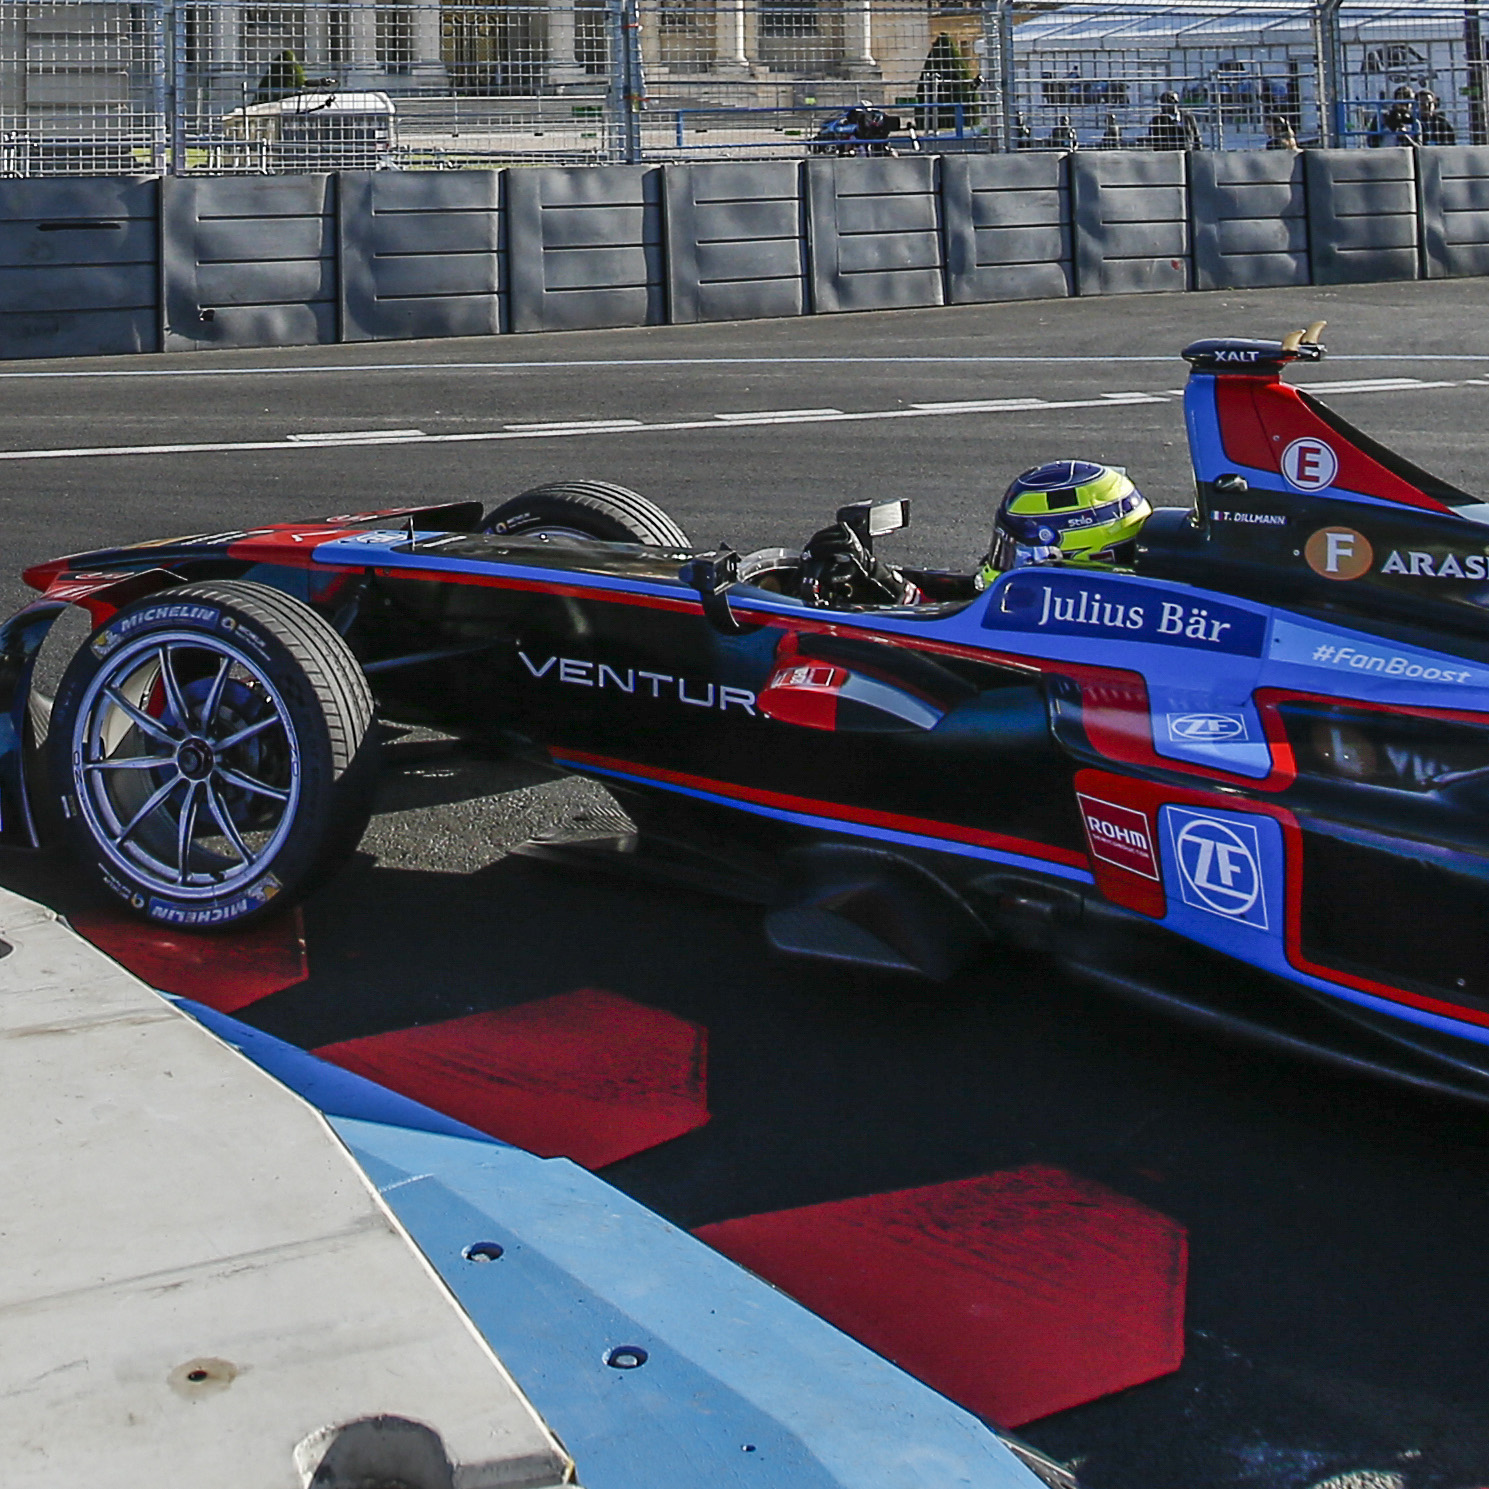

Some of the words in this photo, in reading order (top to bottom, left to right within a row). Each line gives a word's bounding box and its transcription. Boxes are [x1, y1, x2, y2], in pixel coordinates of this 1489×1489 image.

[1214, 350, 1260, 363] XALT
[1296, 446, 1323, 483] E
[1222, 511, 1232, 522] T.
[1234, 512, 1287, 525] DILLMANN
[120, 605, 215, 633] MICHELIN
[1038, 586, 1145, 629] Julius
[1157, 601, 1232, 643] Bär
[1312, 644, 1472, 685] #FanBoost
[518, 651, 770, 718] VENTUR
[1174, 714, 1241, 739] ZF
[1086, 815, 1148, 850] ROHM
[1180, 833, 1256, 901] ZF
[151, 898, 248, 923] MICHELIN
